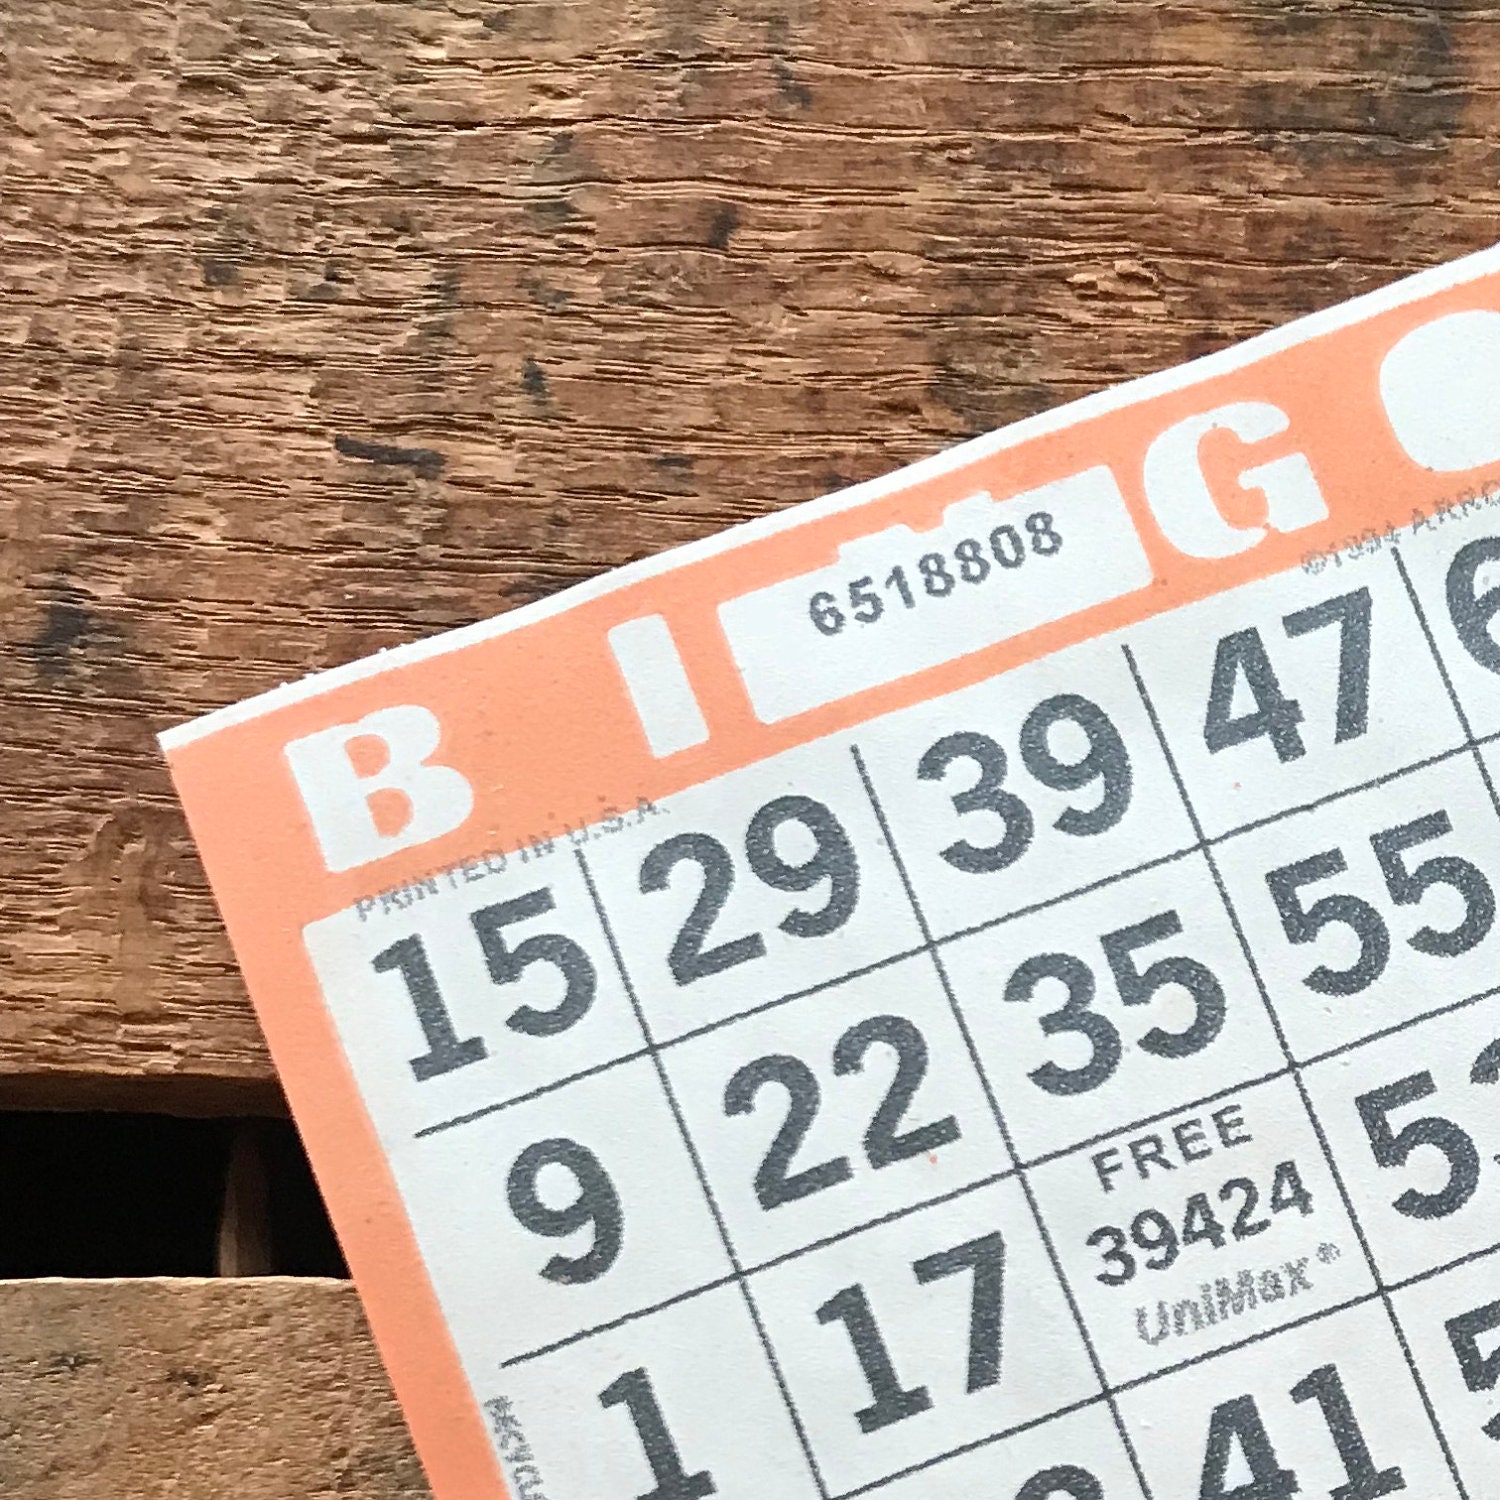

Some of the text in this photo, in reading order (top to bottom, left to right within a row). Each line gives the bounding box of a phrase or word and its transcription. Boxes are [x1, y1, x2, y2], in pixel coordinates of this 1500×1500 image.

[808, 511, 1063, 637] 6518808
[354, 847, 507, 922] PRINTED
[515, 830, 556, 864] IN
[371, 887, 596, 1083] 15
[638, 795, 860, 987] 29
[917, 693, 1133, 874] 39
[1203, 586, 1373, 764] 47
[506, 1137, 624, 1286] 9
[723, 1014, 962, 1212] 22
[1003, 909, 1228, 1097] 35
[1264, 809, 1497, 998] 55
[1090, 1104, 1253, 1194] FREE
[1085, 1160, 1314, 1287] 39424
[815, 1230, 1006, 1435] 17
